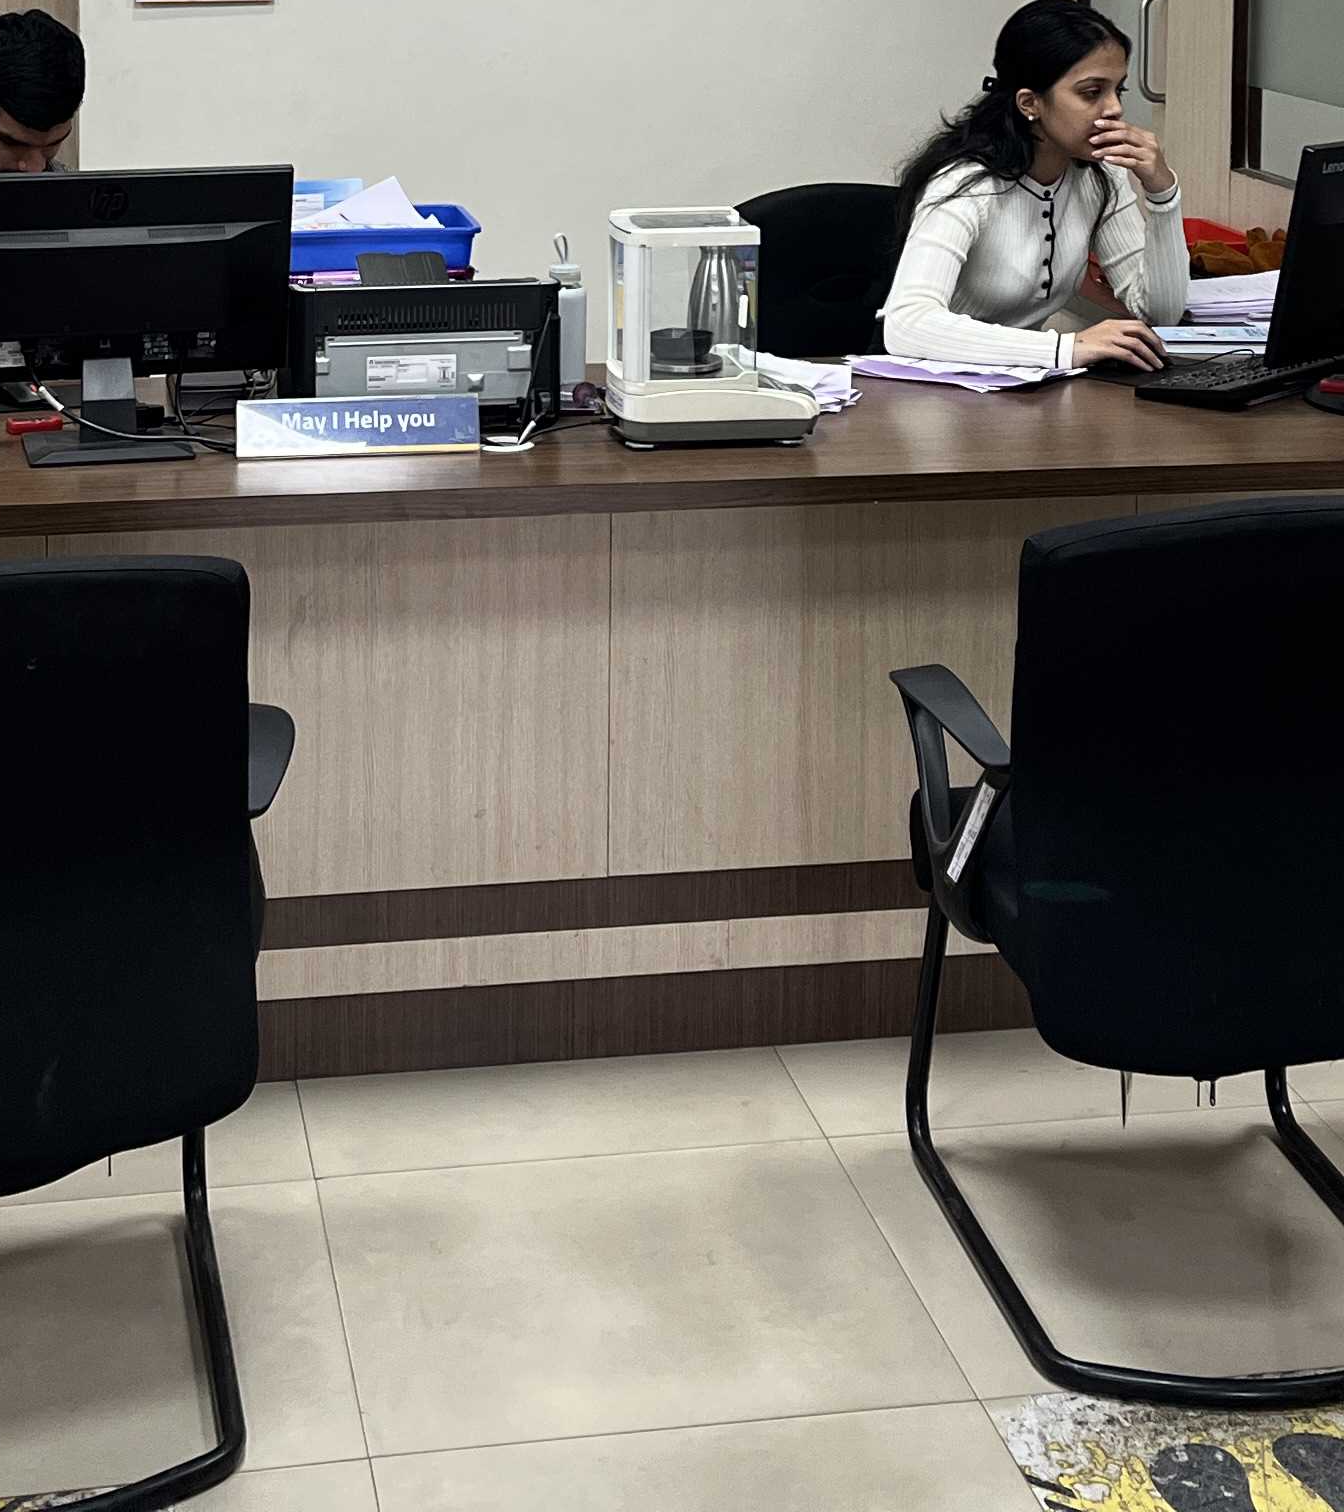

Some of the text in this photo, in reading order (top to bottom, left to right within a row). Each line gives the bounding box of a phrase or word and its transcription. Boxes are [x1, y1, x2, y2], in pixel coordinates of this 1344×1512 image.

[281, 409, 436, 434] May I Help you
